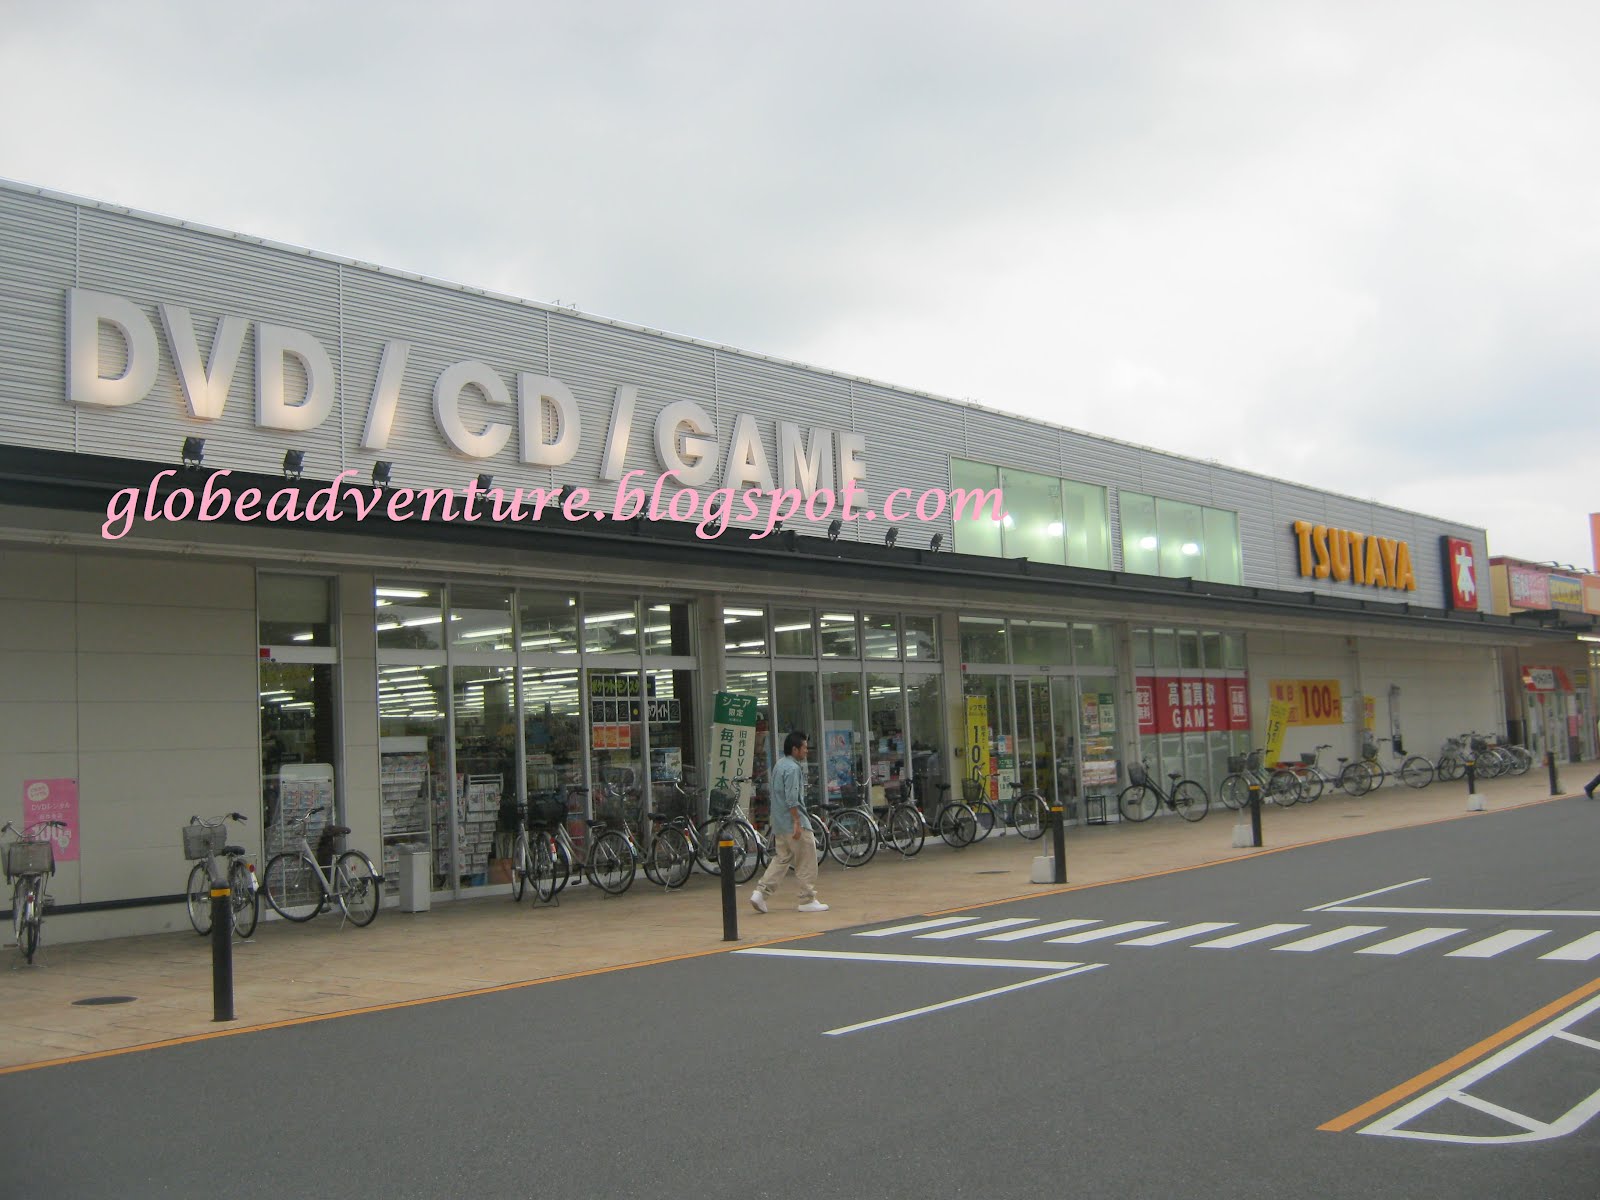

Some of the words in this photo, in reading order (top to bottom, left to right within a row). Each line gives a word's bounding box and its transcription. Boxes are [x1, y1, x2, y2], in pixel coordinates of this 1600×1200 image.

[1293, 520, 1416, 591] TSUTAYA
[722, 696, 751, 708] シニア
[728, 708, 744, 718] 限定
[1172, 709, 1215, 728] GAME
